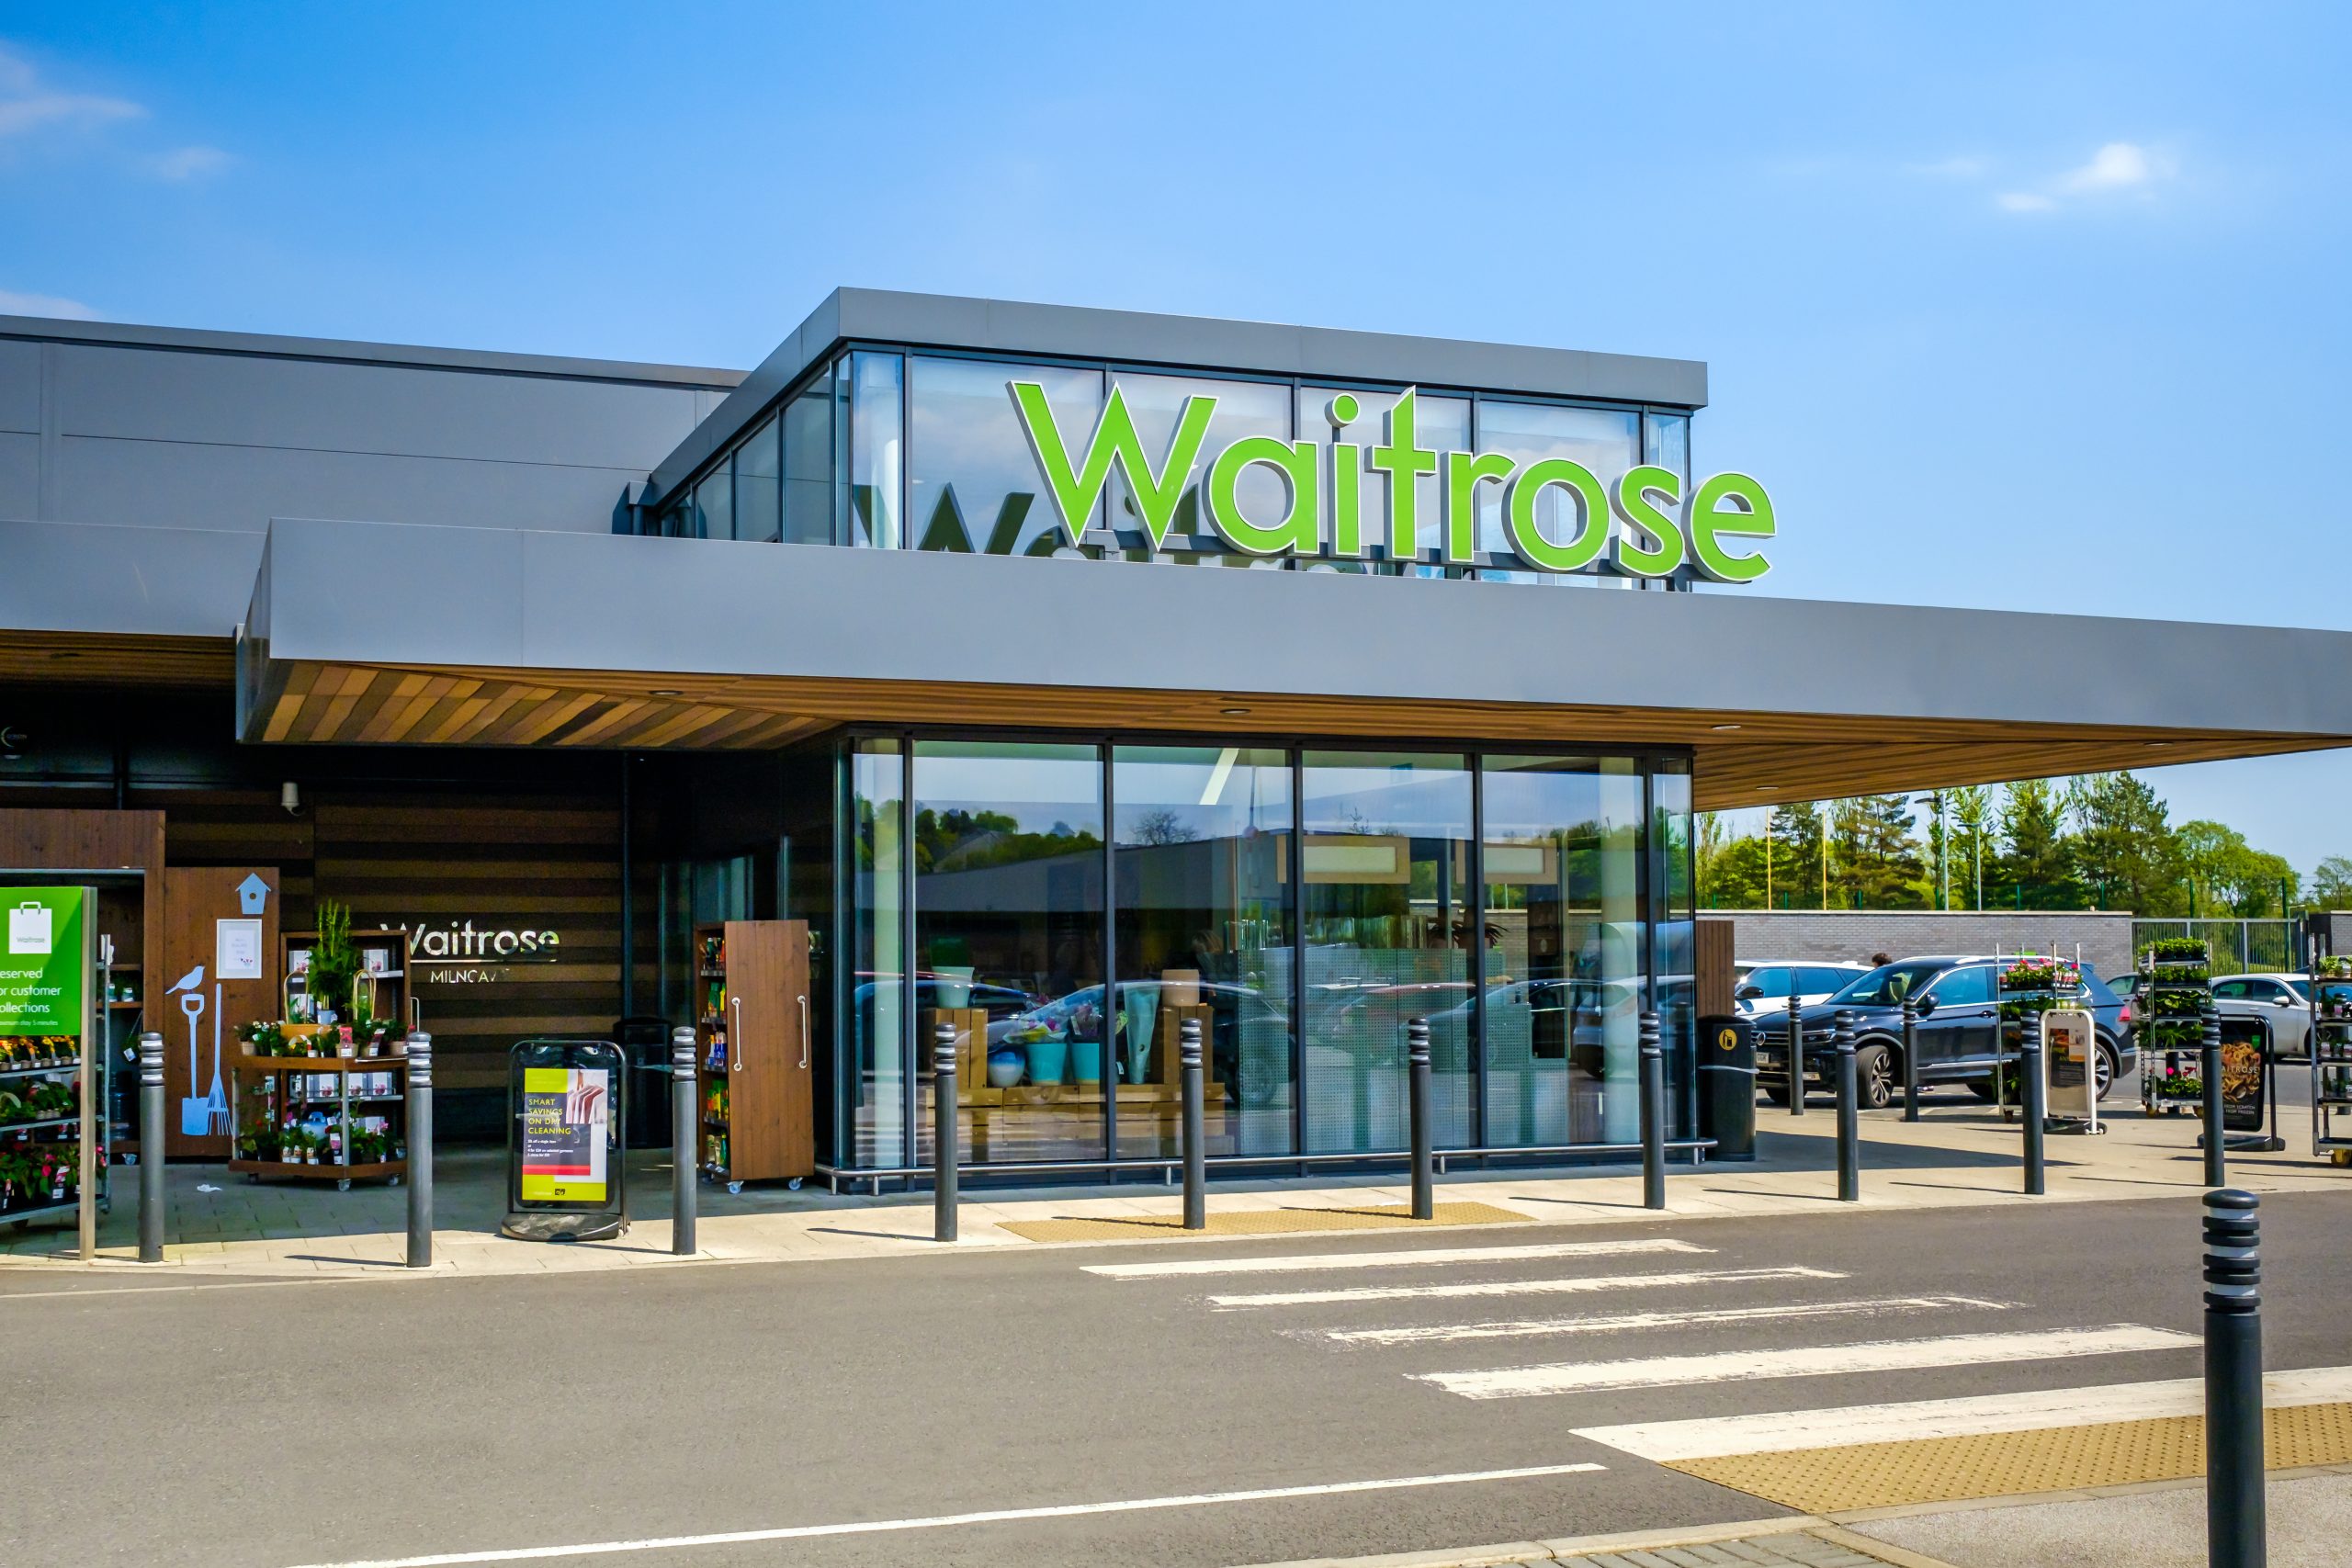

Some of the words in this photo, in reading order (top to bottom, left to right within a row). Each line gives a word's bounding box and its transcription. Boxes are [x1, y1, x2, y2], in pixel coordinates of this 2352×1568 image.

[1005, 379, 1777, 581] Waitrose
[0, 967, 43, 979] eserved
[10, 985, 62, 996] customer
[0, 1002, 51, 1013] ollections
[2221, 1066, 2259, 1074] AITROSE
[528, 1108, 563, 1116] SAVINGS
[528, 1117, 542, 1125] ON
[545, 1117, 561, 1126] DRY
